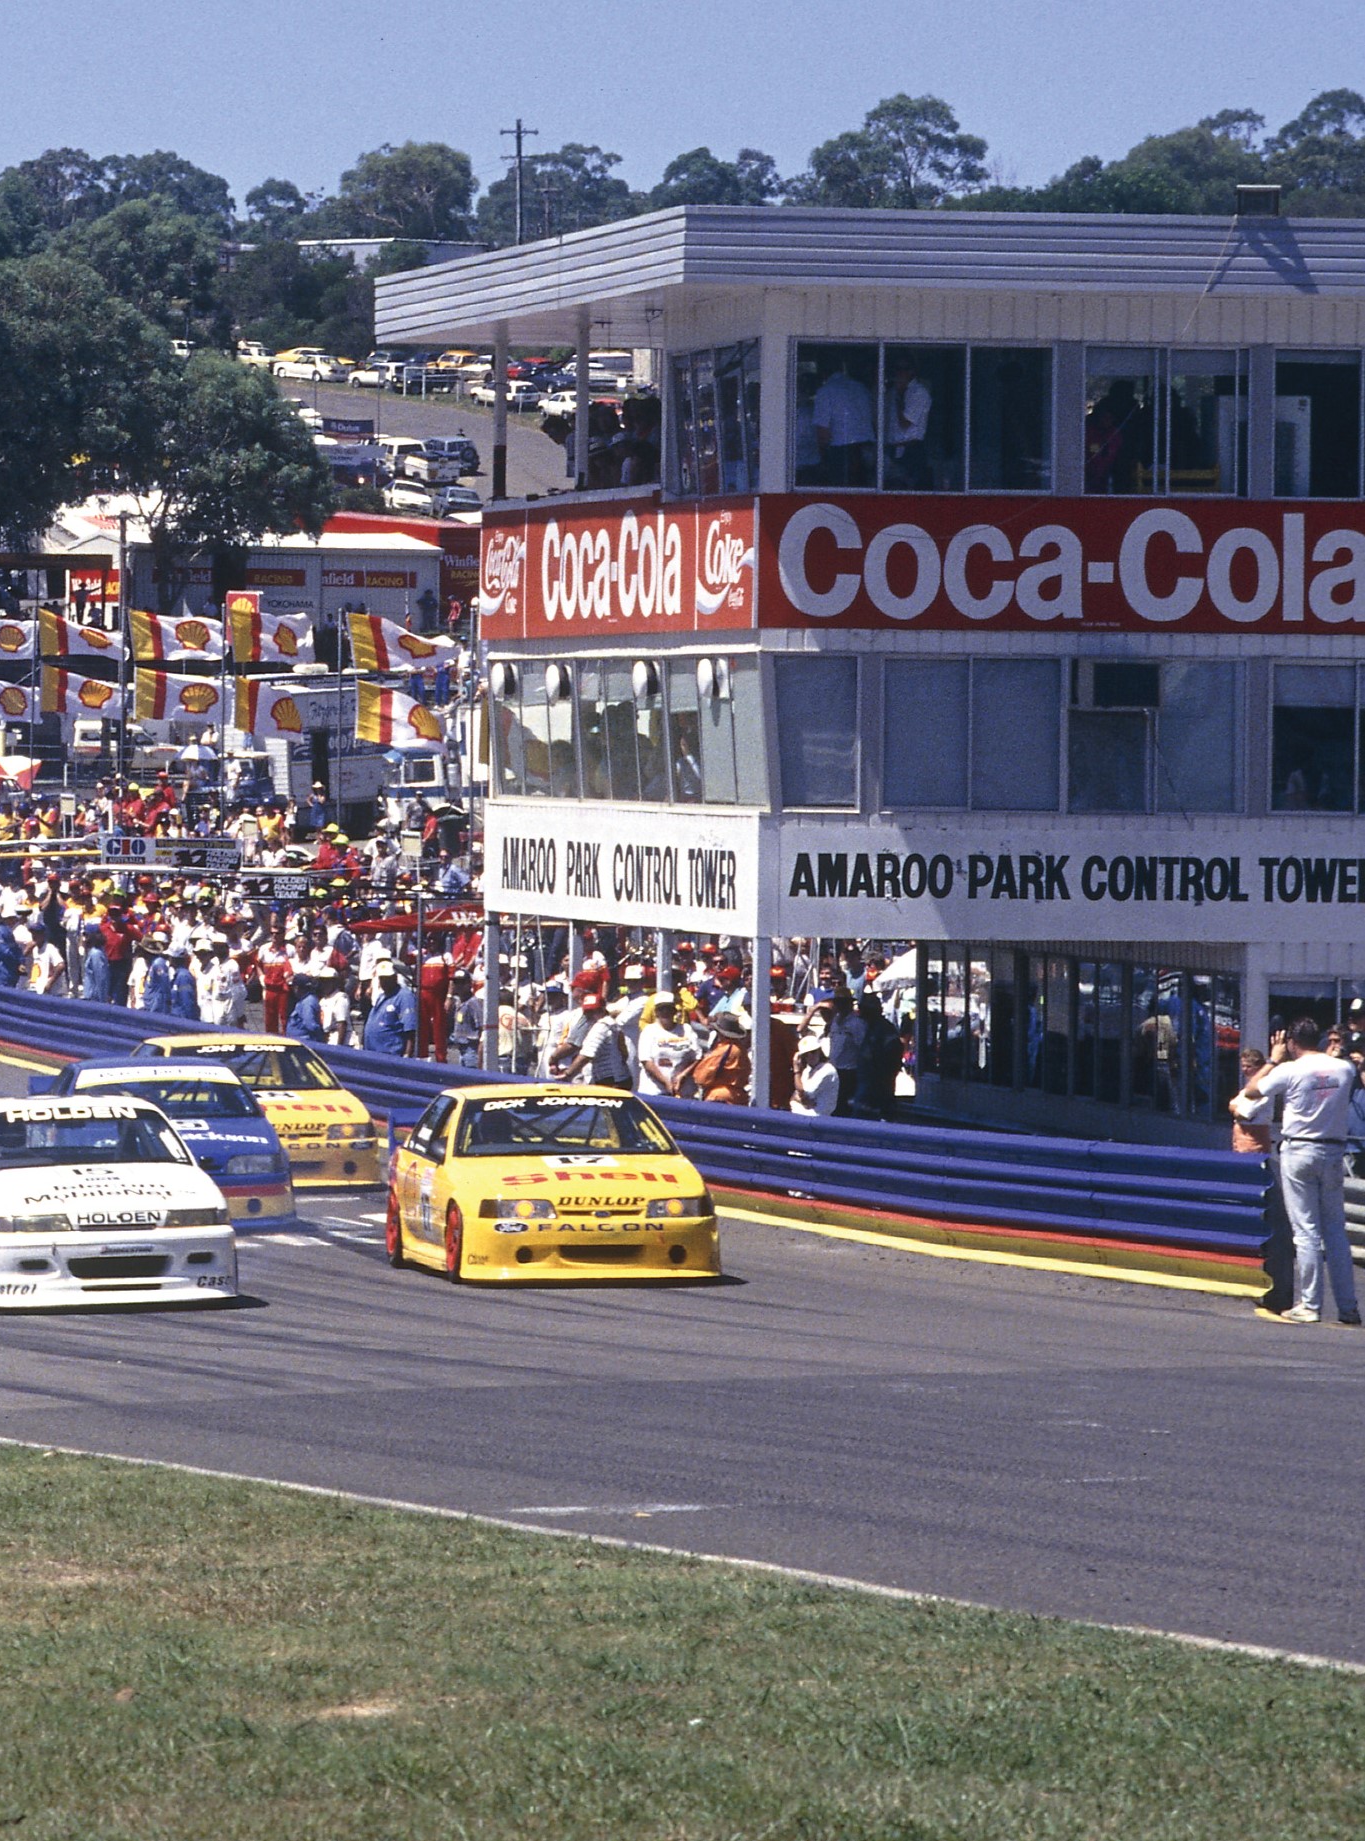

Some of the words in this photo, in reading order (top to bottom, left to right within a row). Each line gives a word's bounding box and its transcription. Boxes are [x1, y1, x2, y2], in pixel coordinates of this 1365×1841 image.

[705, 519, 743, 585] Coke
[542, 509, 681, 621] Coca-Cola
[778, 503, 1365, 623] Coca-Cola
[254, 573, 293, 586] RACING
[322, 570, 355, 586] nfield
[106, 838, 146, 855] GIO
[502, 837, 556, 893] AMAROO
[567, 841, 601, 898] PARK
[613, 844, 681, 905] CONTROL
[688, 848, 736, 910] TOWER
[789, 852, 954, 898] AMAROO
[968, 854, 1071, 900] PARK
[1081, 855, 1249, 902] CONTROL
[1259, 858, 1365, 903] TOWE
[196, 1045, 236, 1054] JOHN
[260, 1103, 353, 1115] hell
[484, 1098, 527, 1111] DICK
[536, 1096, 623, 1108] JOHNSON
[6, 1106, 138, 1123] HOLDEN
[272, 1122, 327, 1131] UNLOP
[182, 1132, 269, 1144] ackson
[288, 1142, 340, 1150] CON
[501, 1171, 679, 1186] Shell
[557, 1196, 647, 1206] DUNLOP
[77, 1211, 162, 1224] HOLDEN
[537, 1222, 665, 1232] FALCON
